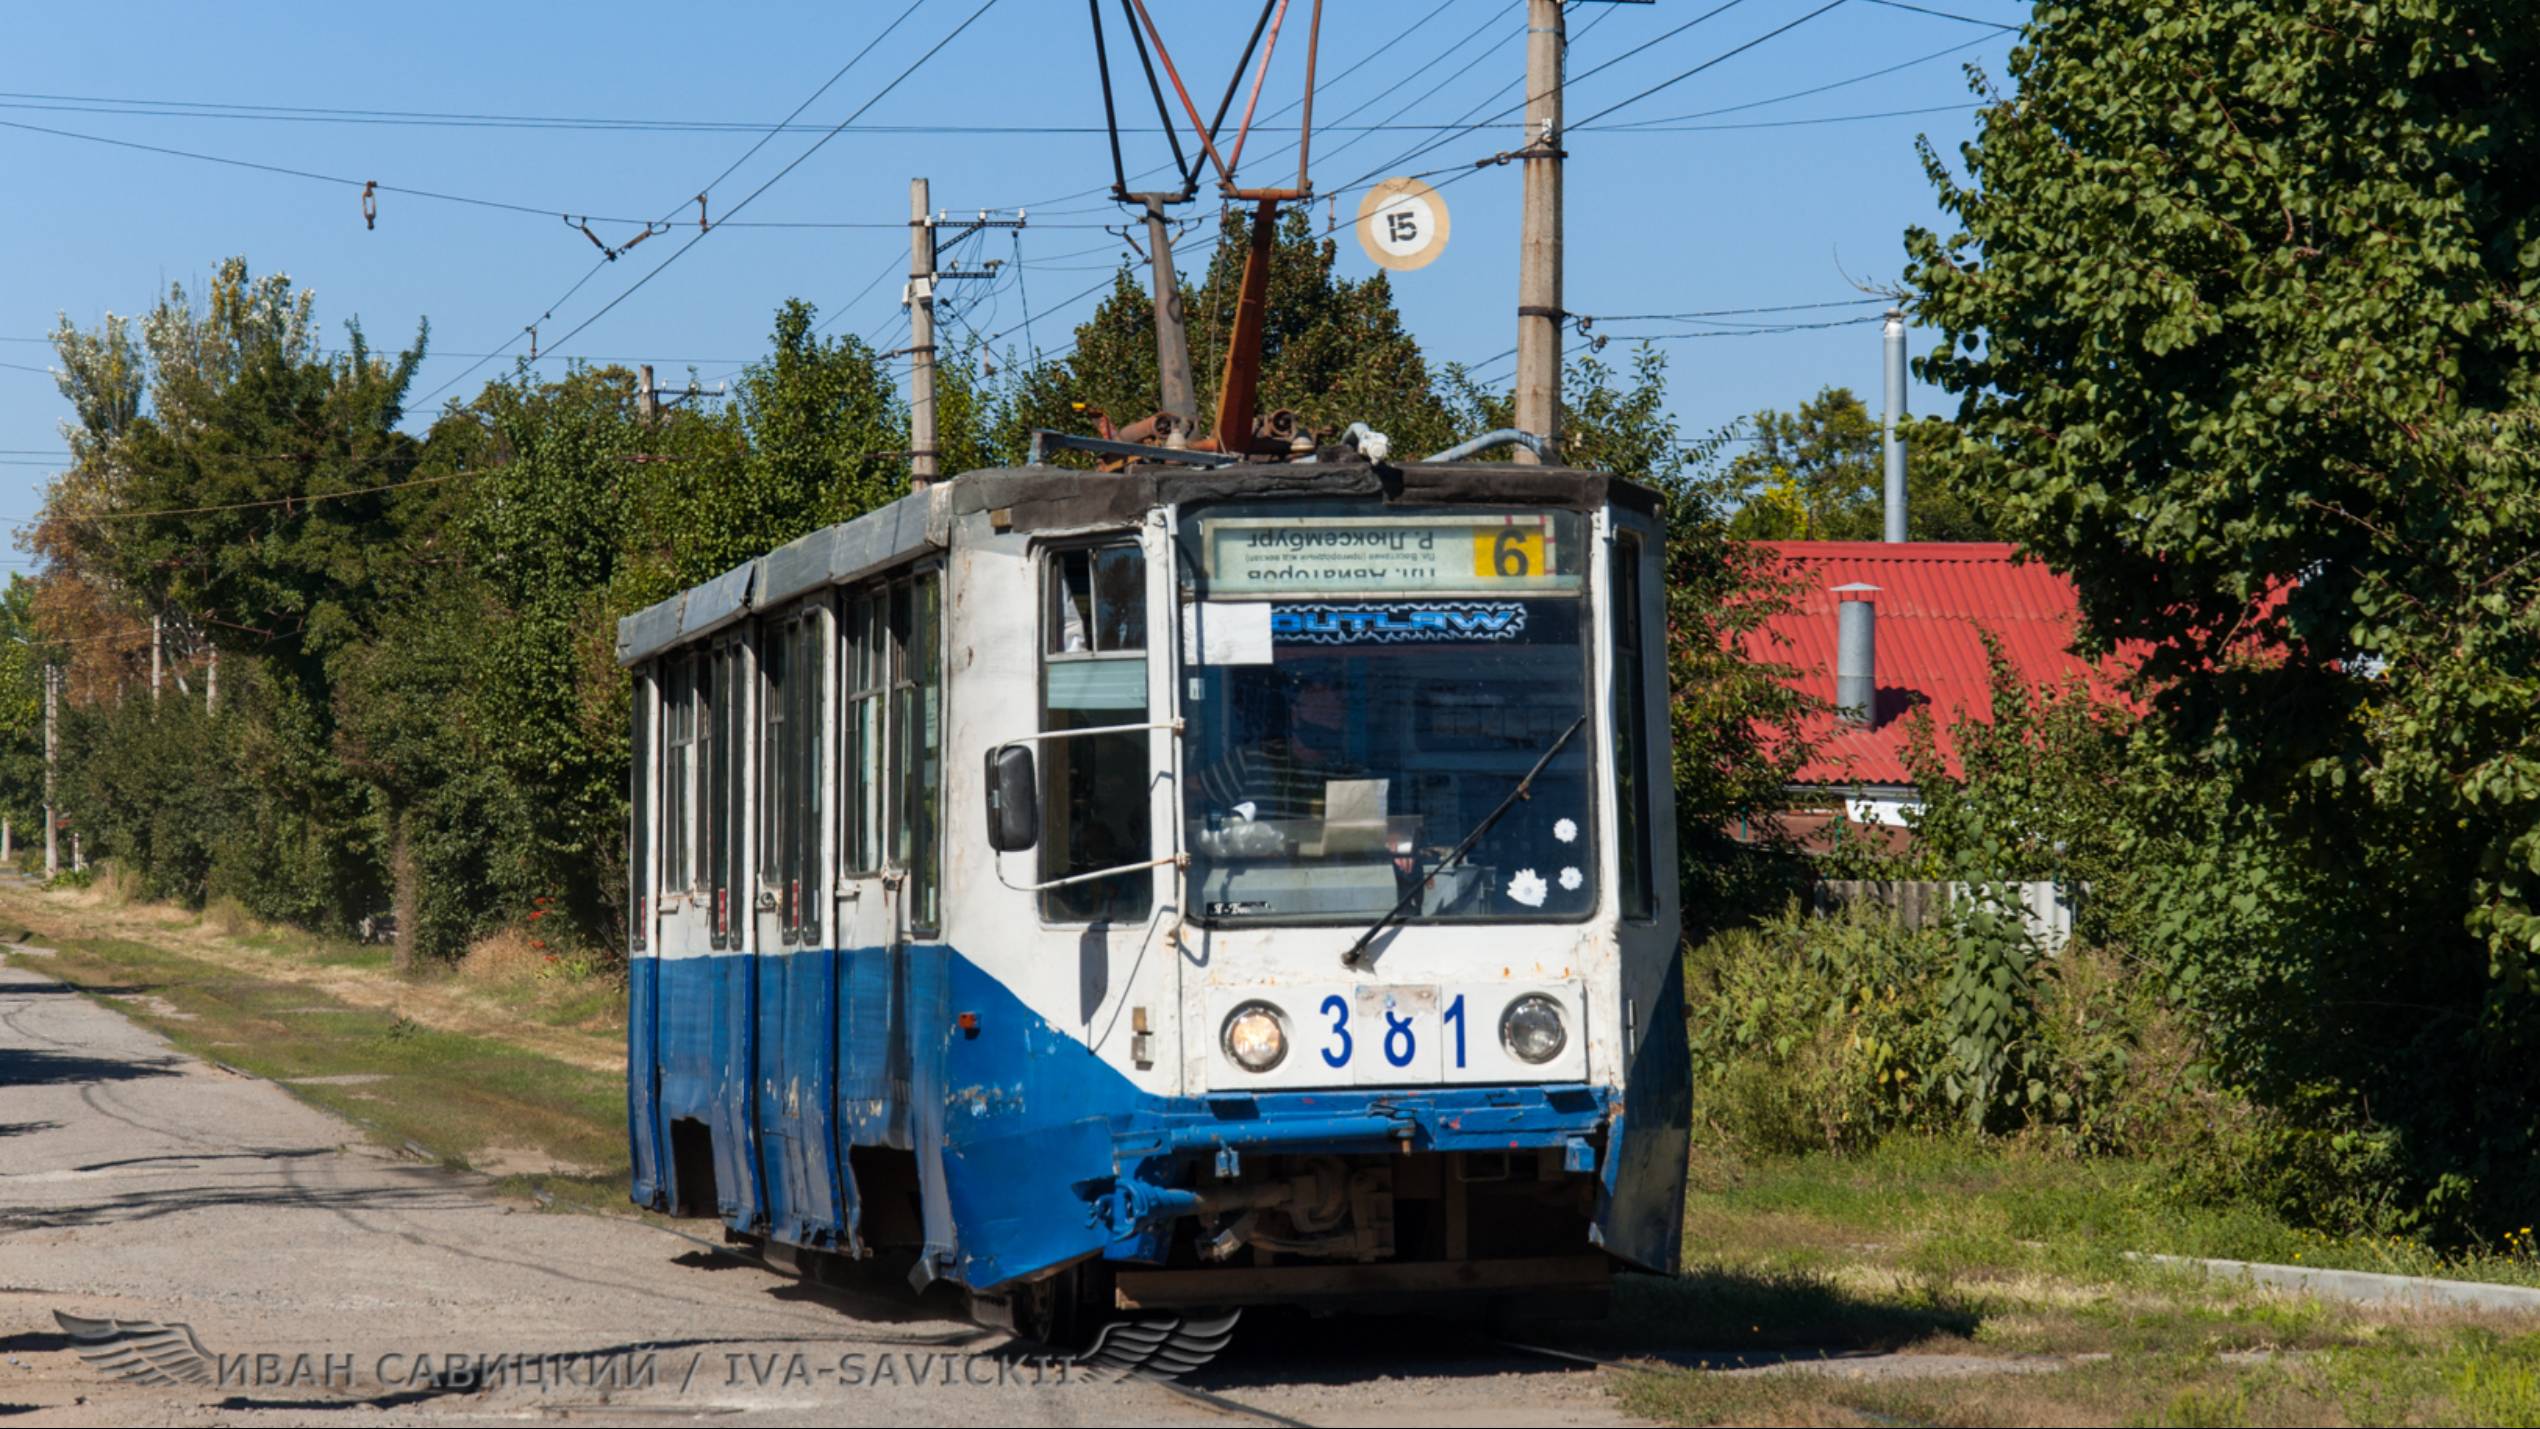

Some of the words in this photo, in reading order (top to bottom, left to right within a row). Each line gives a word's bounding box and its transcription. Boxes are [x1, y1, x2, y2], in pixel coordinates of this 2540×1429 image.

[1386, 211, 1418, 243] 15
[1246, 529, 1406, 551] Люксембург
[1414, 531, 1434, 550] Р.
[1271, 612, 1515, 631] OUTLAW
[1319, 994, 1466, 1069] 381
